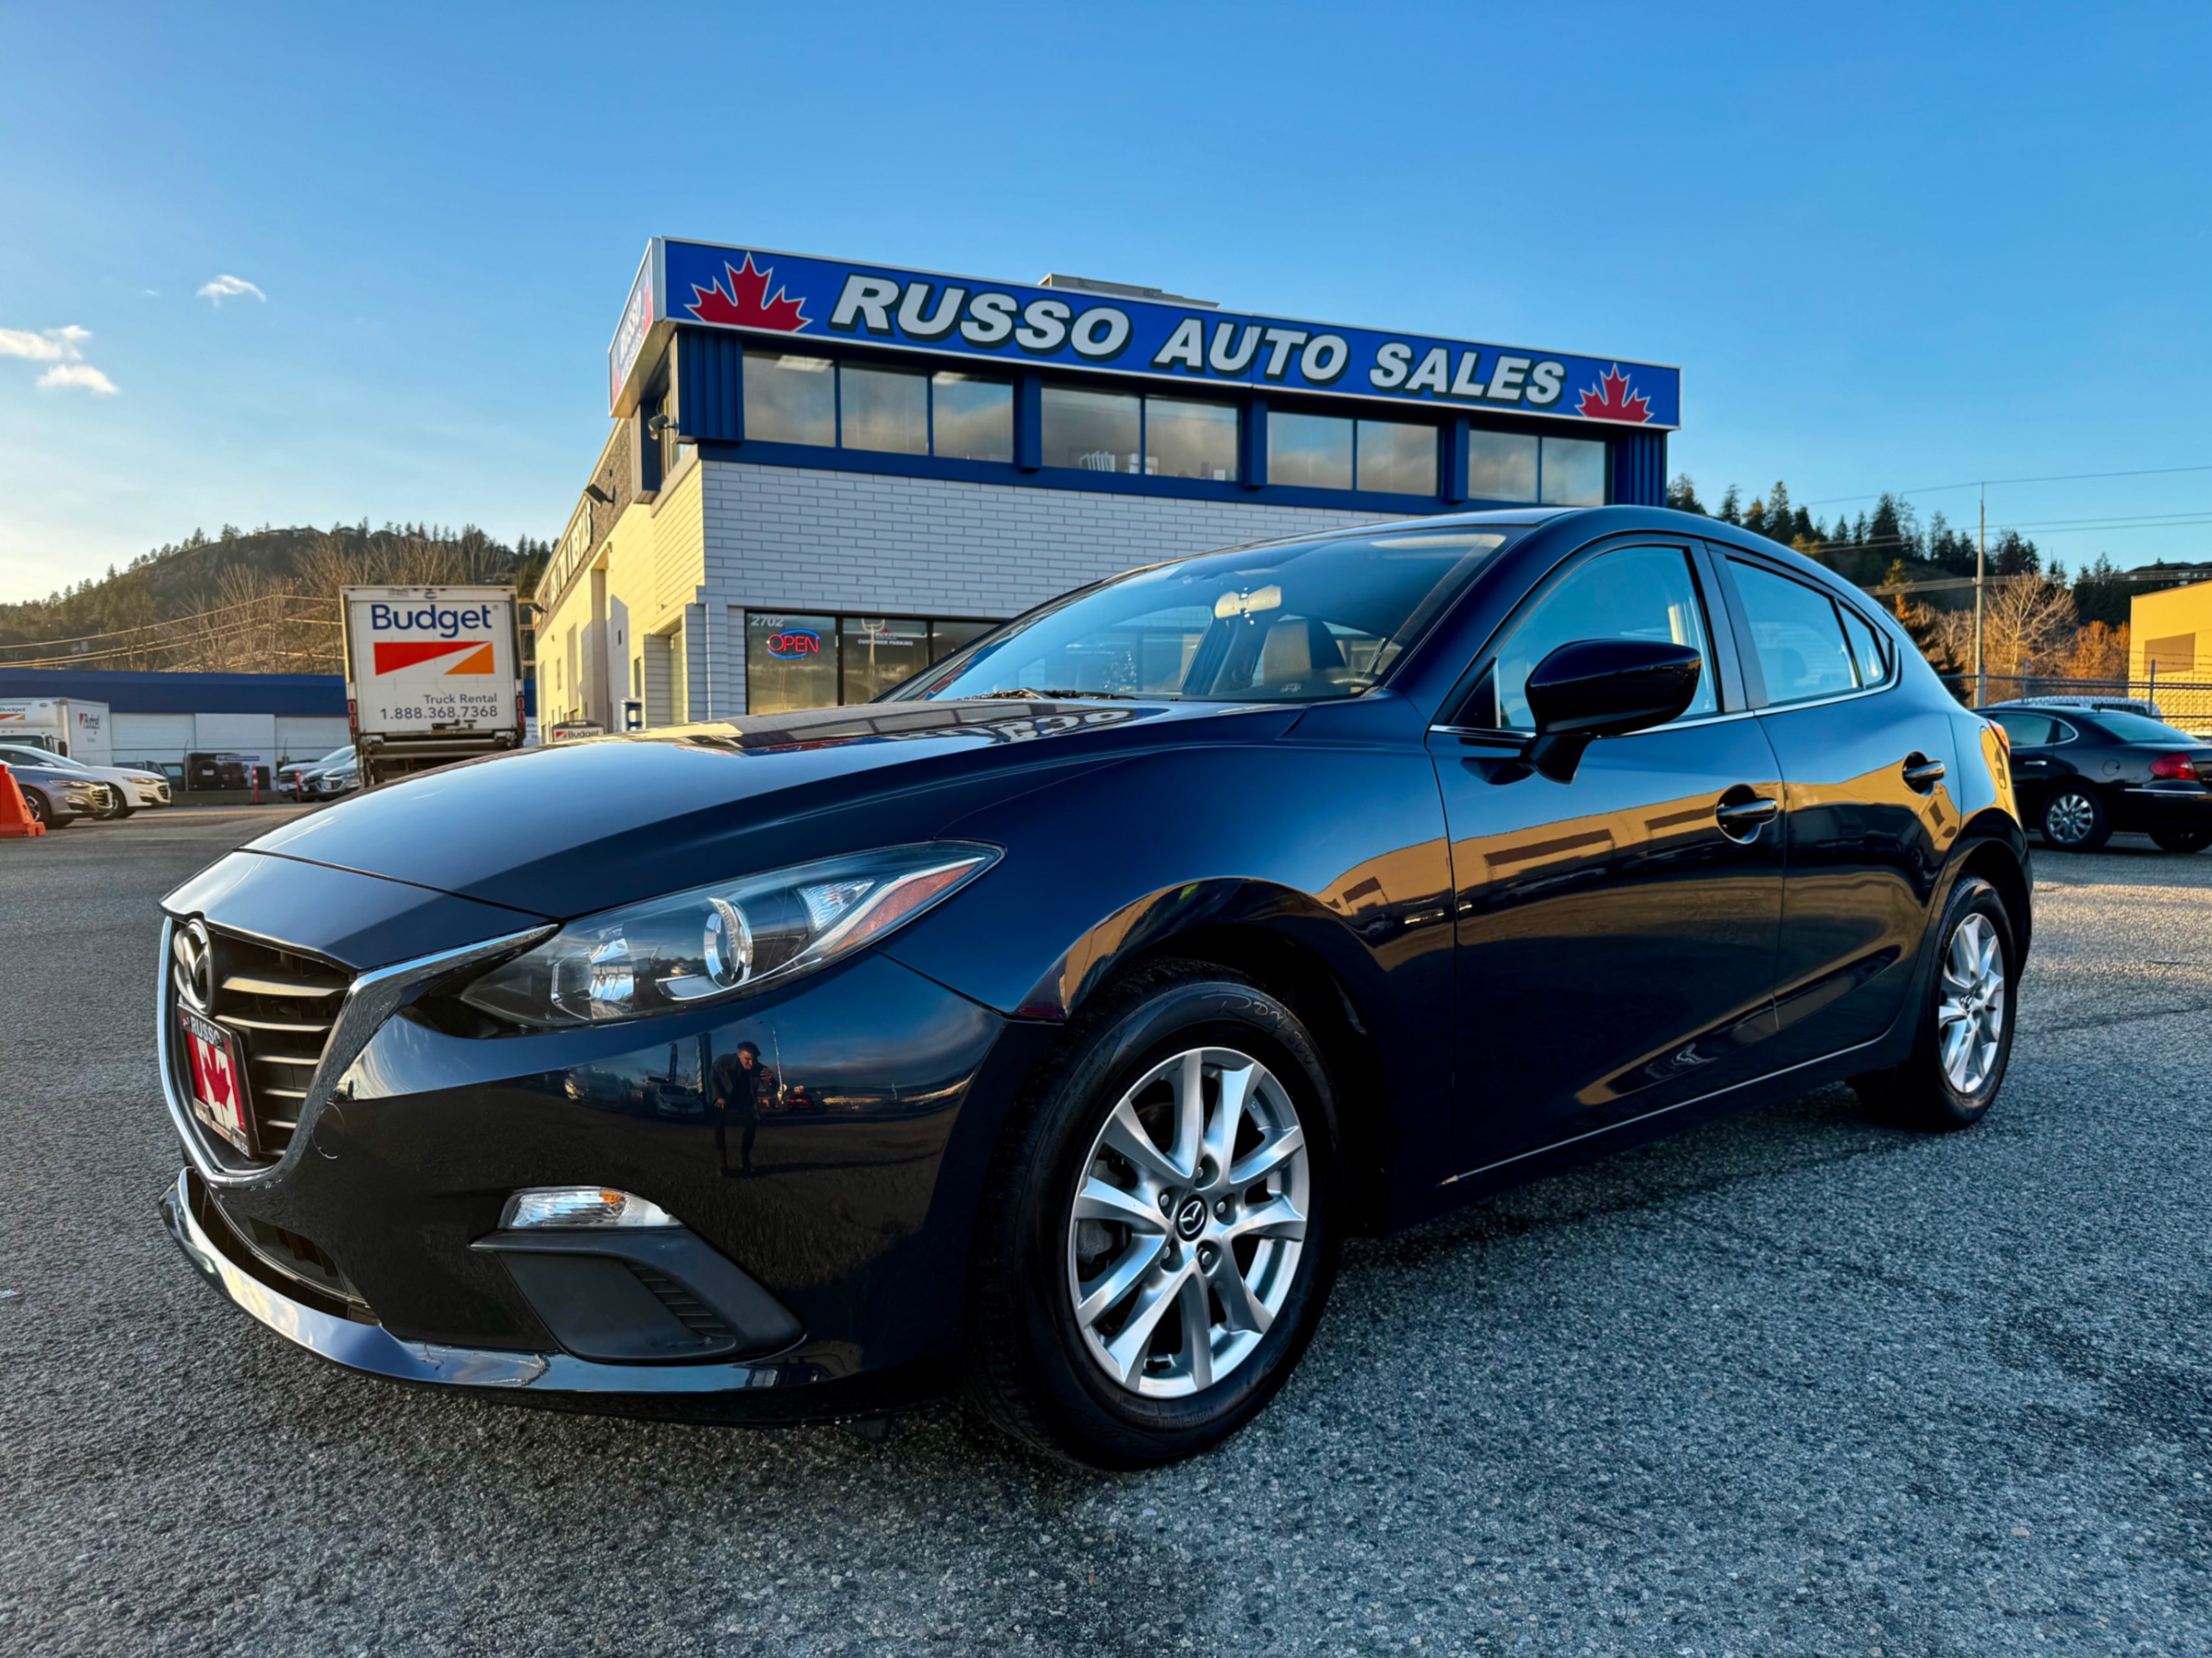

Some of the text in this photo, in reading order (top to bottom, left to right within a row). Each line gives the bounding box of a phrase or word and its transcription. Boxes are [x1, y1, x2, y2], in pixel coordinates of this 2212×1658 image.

[830, 274, 1566, 408] RUSSO AUTO SALES
[372, 605, 491, 638] Budget
[751, 616, 783, 627] 2702
[768, 634, 820, 653] OPEN
[424, 693, 497, 704] Truck Rental
[380, 706, 498, 720] 1.888.368.7368
